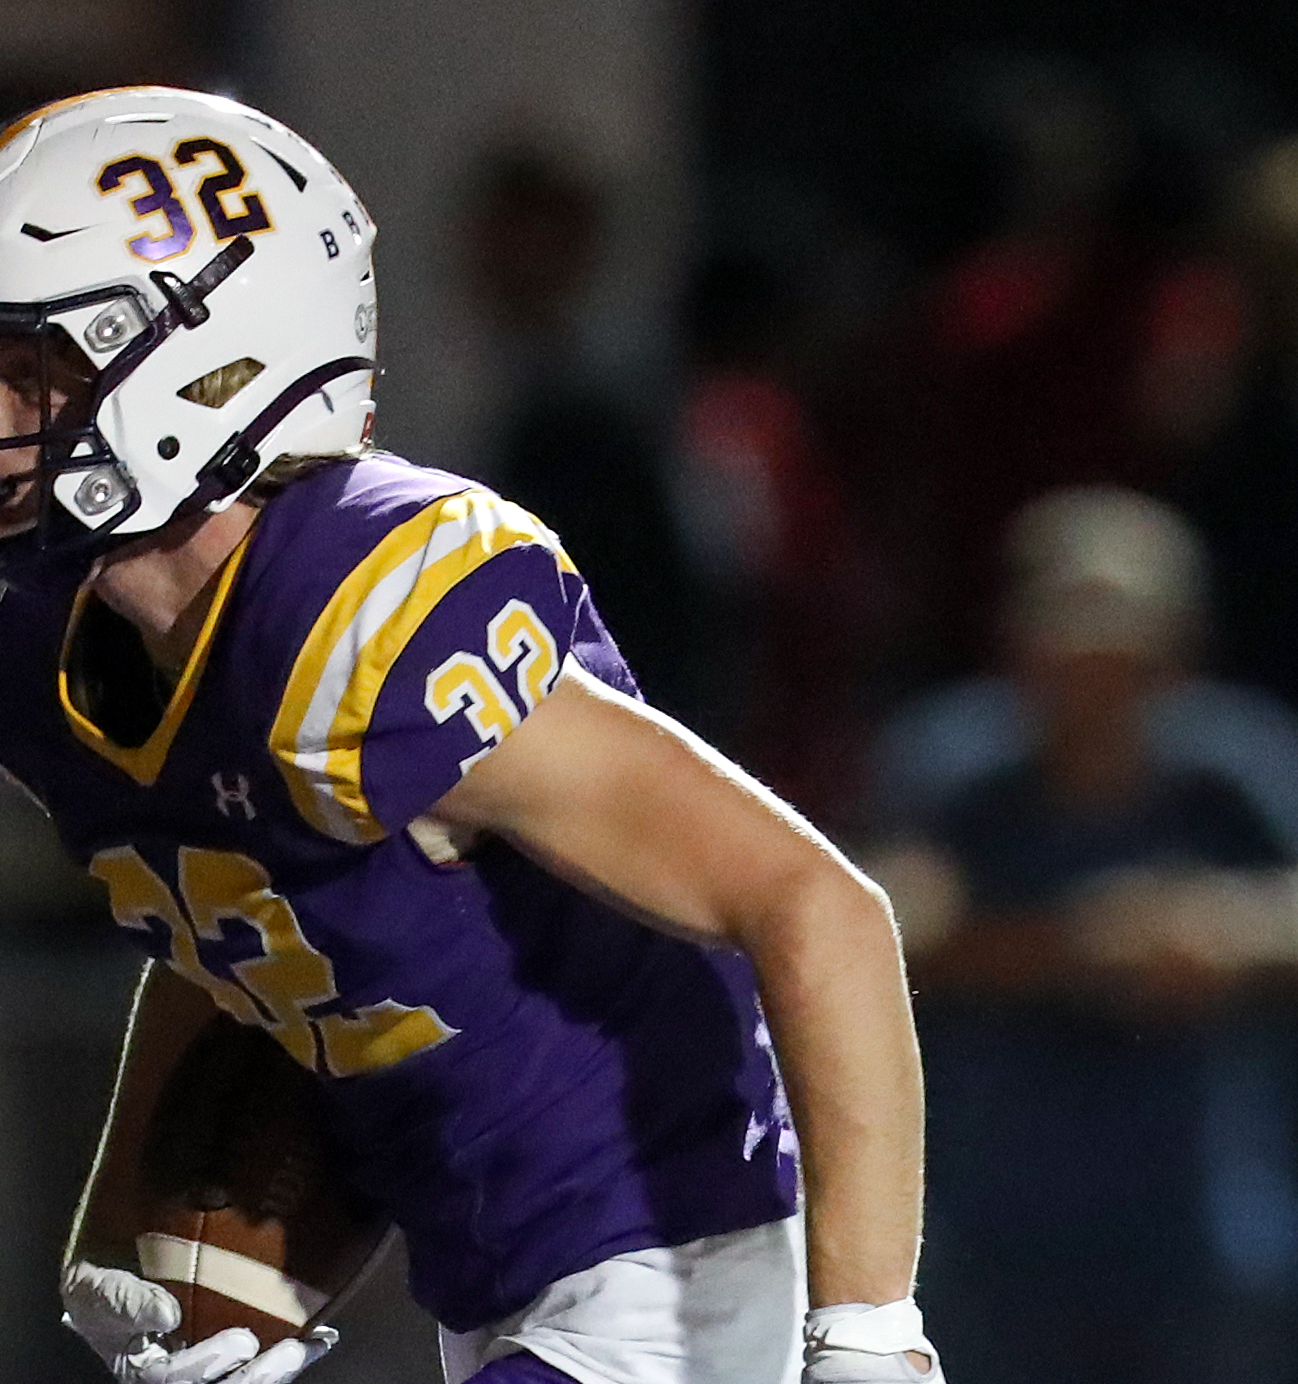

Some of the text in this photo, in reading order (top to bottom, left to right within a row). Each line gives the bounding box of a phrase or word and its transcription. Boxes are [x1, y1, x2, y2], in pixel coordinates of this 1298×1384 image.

[95, 136, 276, 264] 32
[424, 598, 559, 776] 32
[89, 845, 463, 1078] 32
